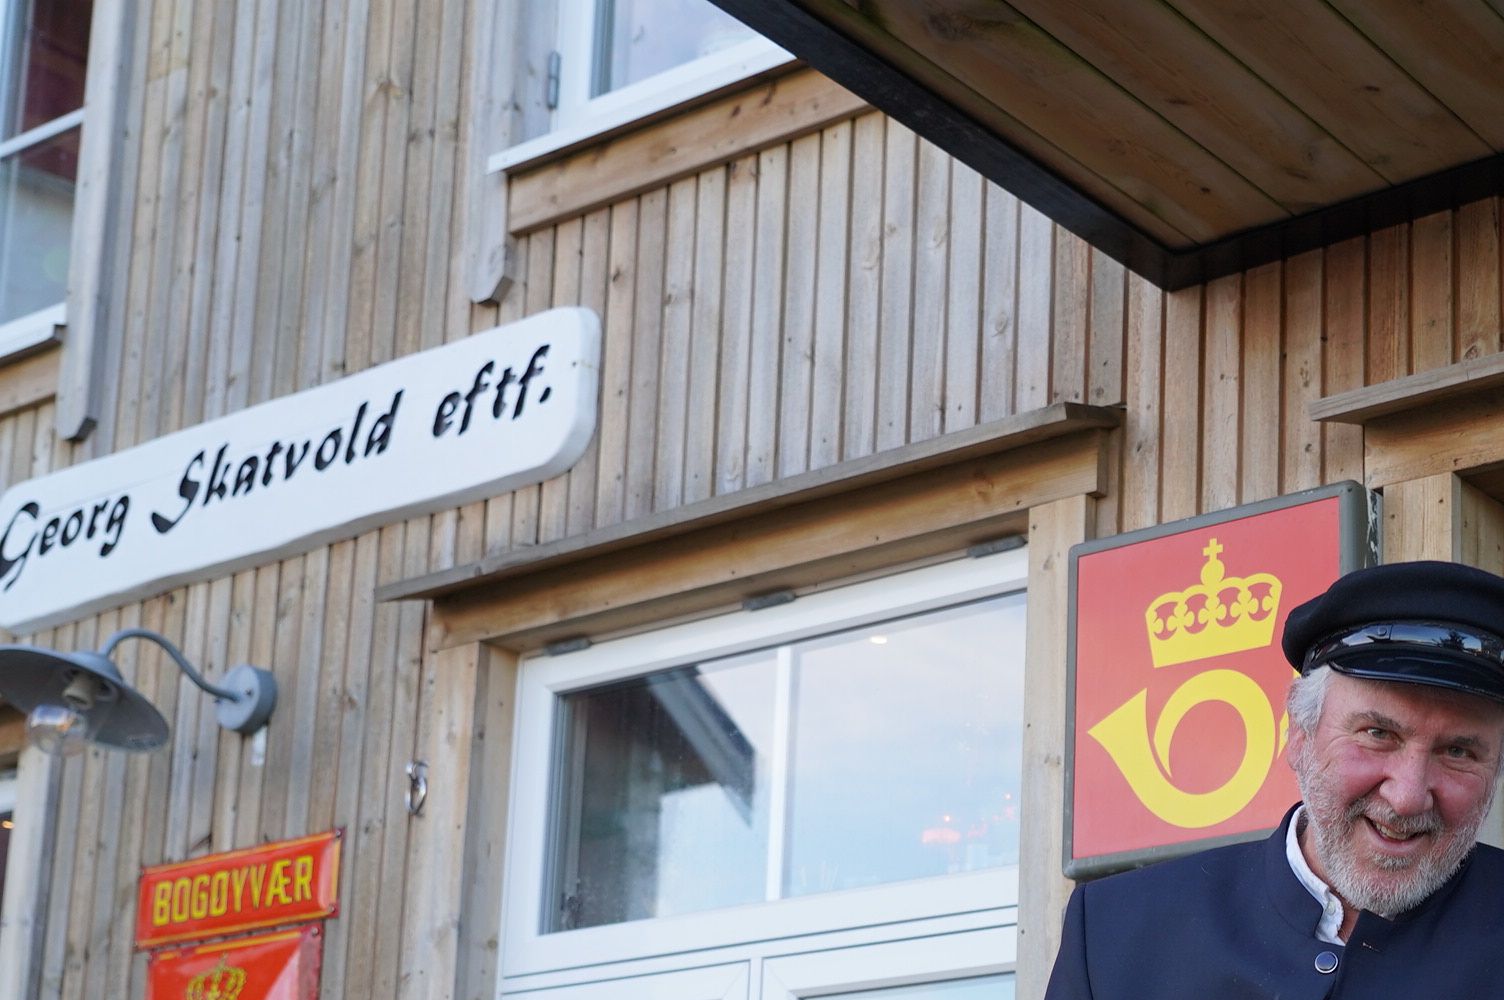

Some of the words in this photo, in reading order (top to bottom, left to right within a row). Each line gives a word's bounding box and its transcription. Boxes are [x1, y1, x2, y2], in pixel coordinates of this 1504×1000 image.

[0, 495, 129, 592] Georg
[151, 389, 404, 534] Skatvold
[433, 344, 551, 437] eftf.
[153, 855, 314, 926] BOGØYVÆR
